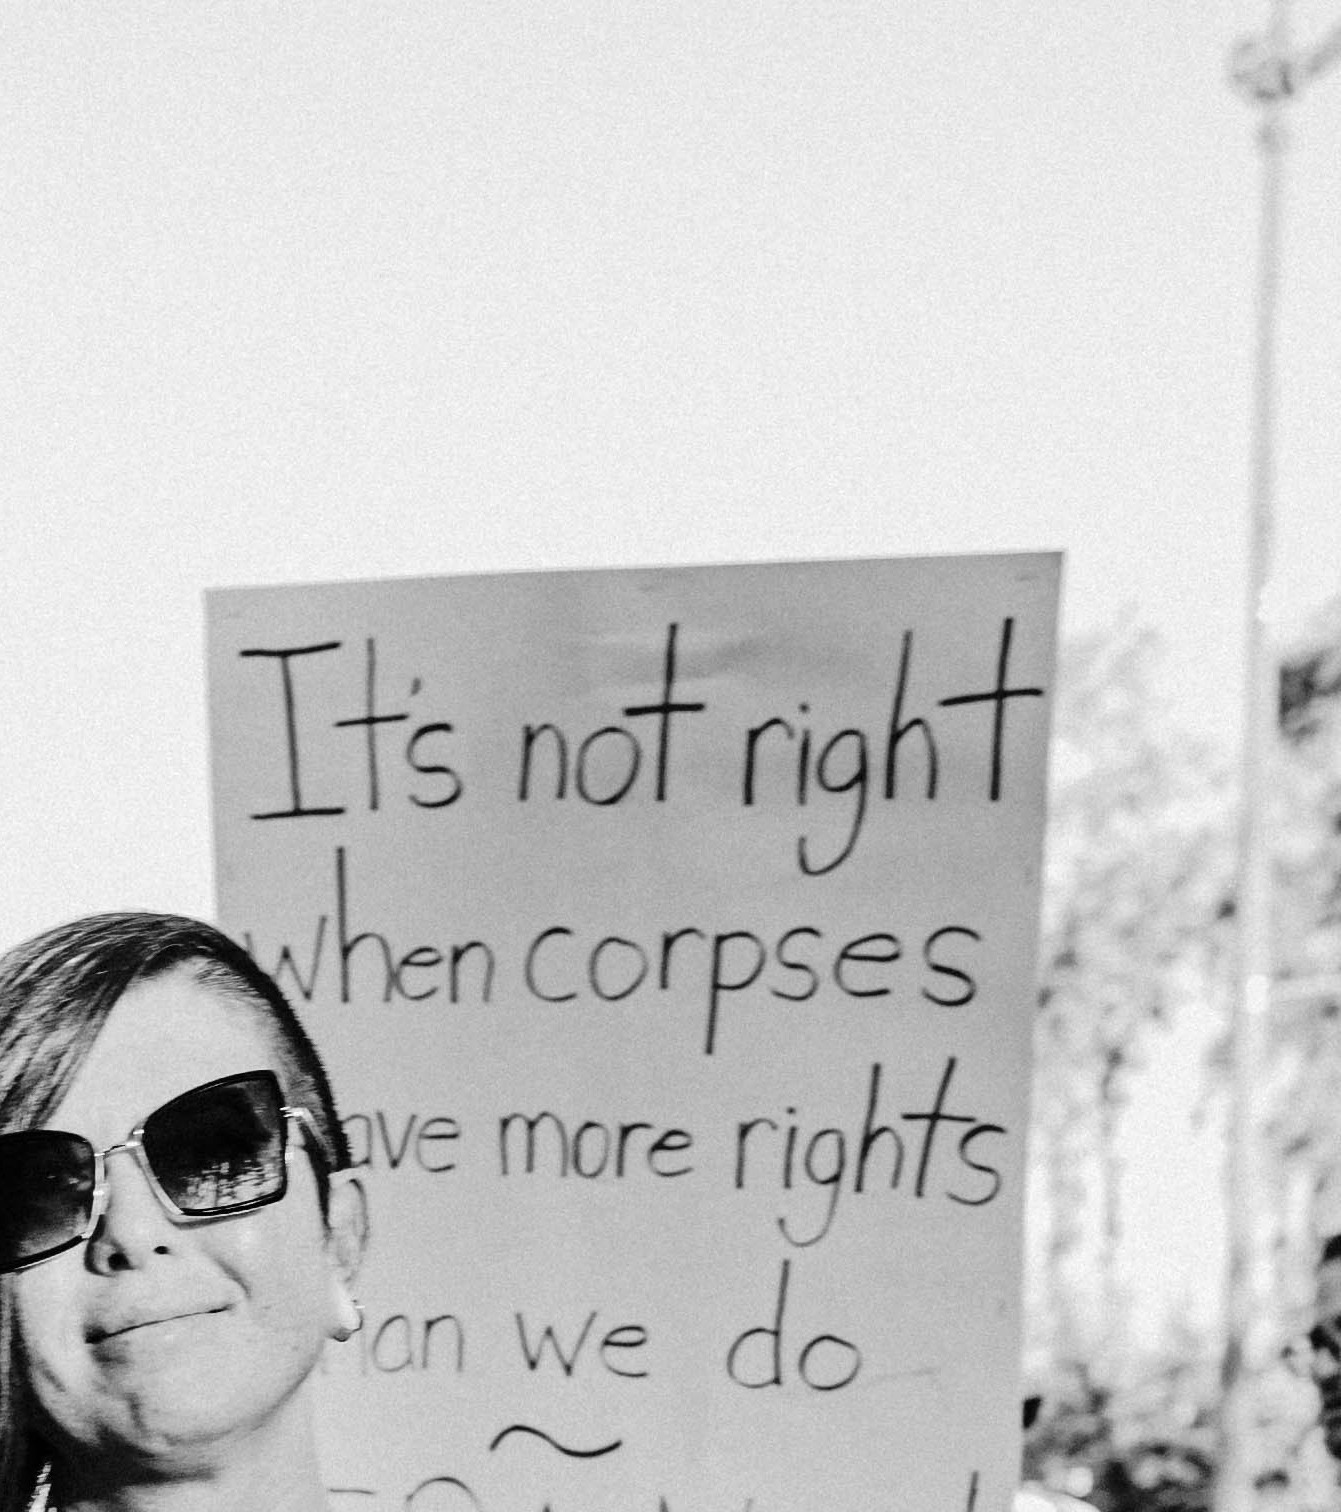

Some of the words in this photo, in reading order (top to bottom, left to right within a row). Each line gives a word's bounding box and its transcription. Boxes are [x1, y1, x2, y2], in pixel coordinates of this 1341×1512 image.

[239, 636, 465, 820] It's
[517, 622, 707, 806] not
[742, 616, 1045, 876] right
[243, 846, 495, 1004] when
[523, 922, 984, 1056] corpses
[339, 1108, 462, 1175] ave
[498, 1107, 696, 1182] more
[734, 1056, 1009, 1248] rights
[516, 1307, 651, 1383] we
[726, 1258, 864, 1392] do
